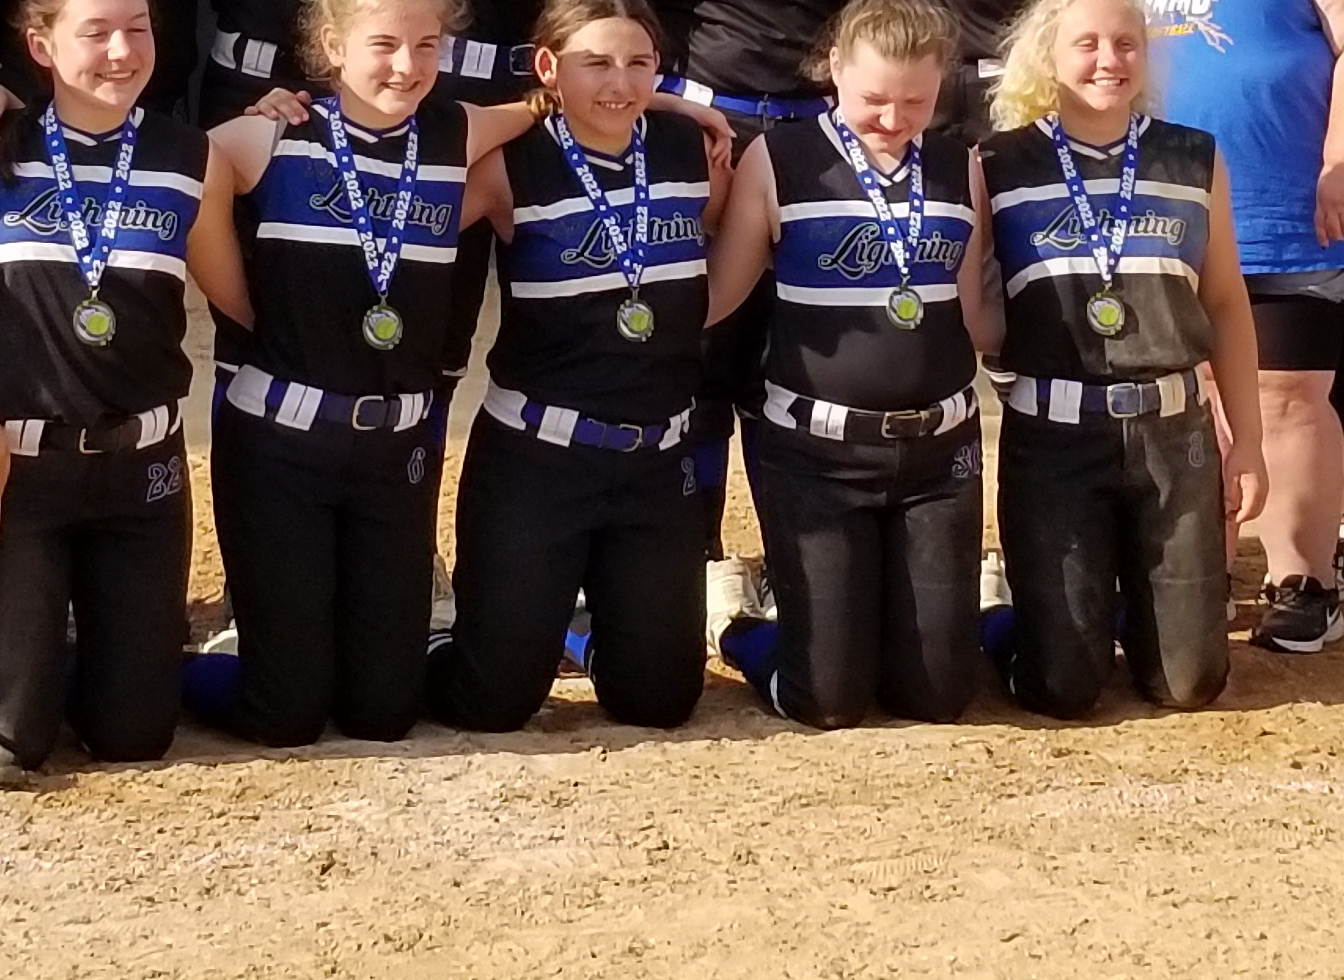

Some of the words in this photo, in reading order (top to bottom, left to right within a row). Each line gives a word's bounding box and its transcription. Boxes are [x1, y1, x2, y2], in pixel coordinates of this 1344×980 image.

[329, 111, 347, 150] 2022
[116, 143, 133, 181] 2022
[405, 131, 418, 171] 2022
[635, 151, 647, 188] 2022
[1057, 145, 1077, 180] 2022
[52, 152, 73, 191] 2022
[343, 170, 364, 210] 2022
[576, 164, 602, 200] 2022
[1120, 166, 1136, 201] 2022
[101, 200, 123, 240] 2022
[392, 190, 412, 230] 2022
[636, 205, 648, 244] 2022
[1074, 193, 1096, 229] 2022
[68, 210, 90, 251] 2022
[602, 215, 627, 254] 2022
[1110, 218, 1127, 255] 2022
[359, 231, 379, 270] 2022
[407, 446, 426, 484] 6
